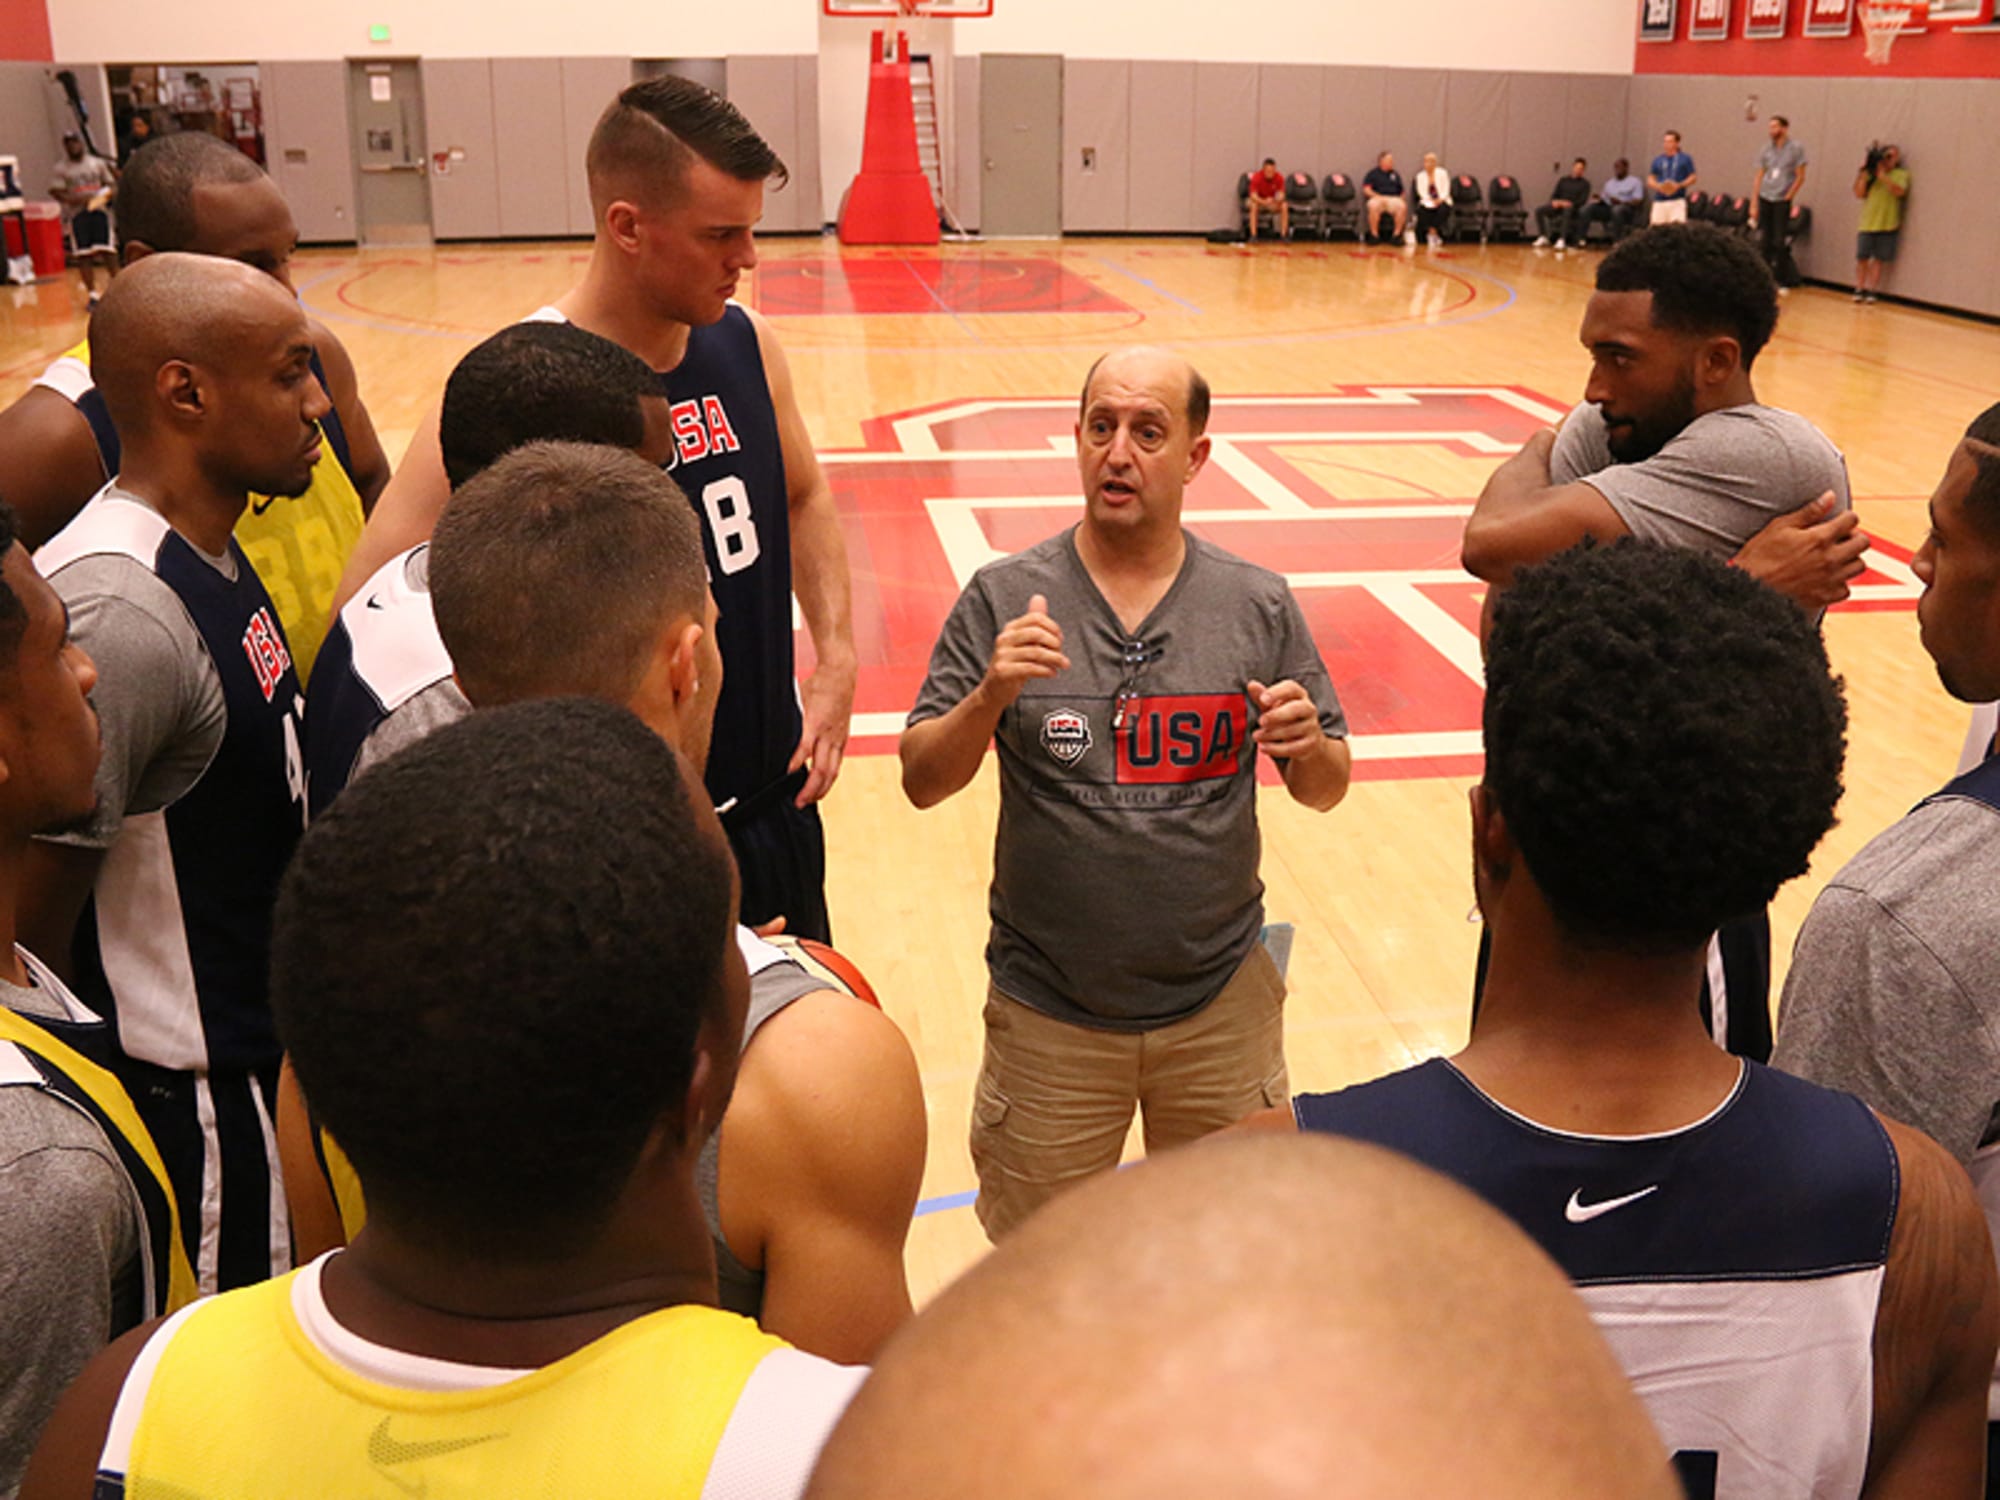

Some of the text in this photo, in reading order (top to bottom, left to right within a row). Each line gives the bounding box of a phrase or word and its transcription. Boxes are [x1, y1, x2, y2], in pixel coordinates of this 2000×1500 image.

[666, 396, 741, 471] SA
[242, 606, 291, 703] USA
[1050, 719, 1080, 734] USA
[1128, 711, 1234, 767] USA
